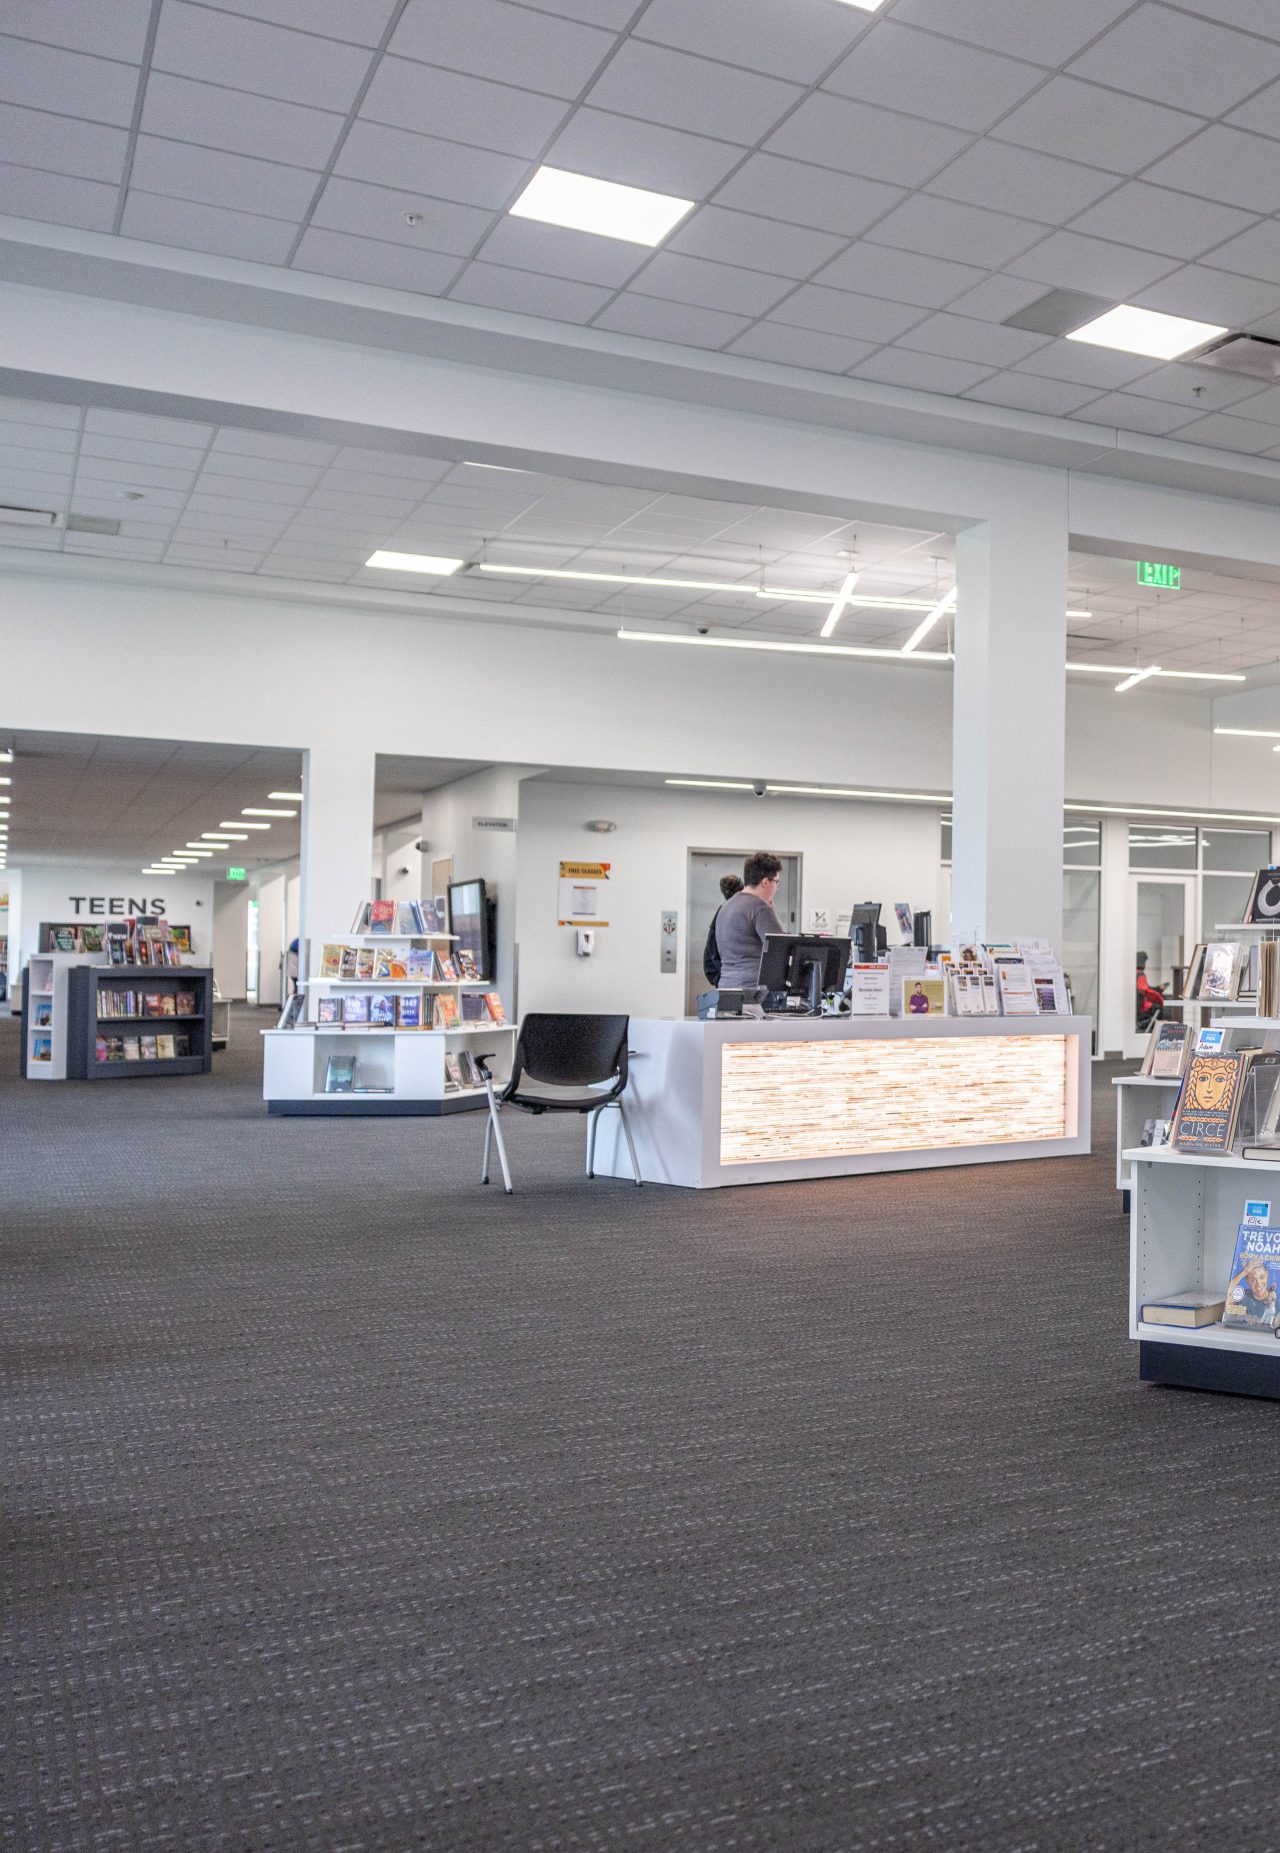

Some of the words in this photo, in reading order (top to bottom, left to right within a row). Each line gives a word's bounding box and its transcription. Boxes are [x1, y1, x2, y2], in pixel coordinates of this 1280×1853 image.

[1144, 561, 1177, 585] EXIT
[581, 867, 602, 875] CLASSES
[68, 896, 166, 916] TEENS
[1180, 1121, 1227, 1137] CIRCE
[1246, 1242, 1280, 1254] NOAH
